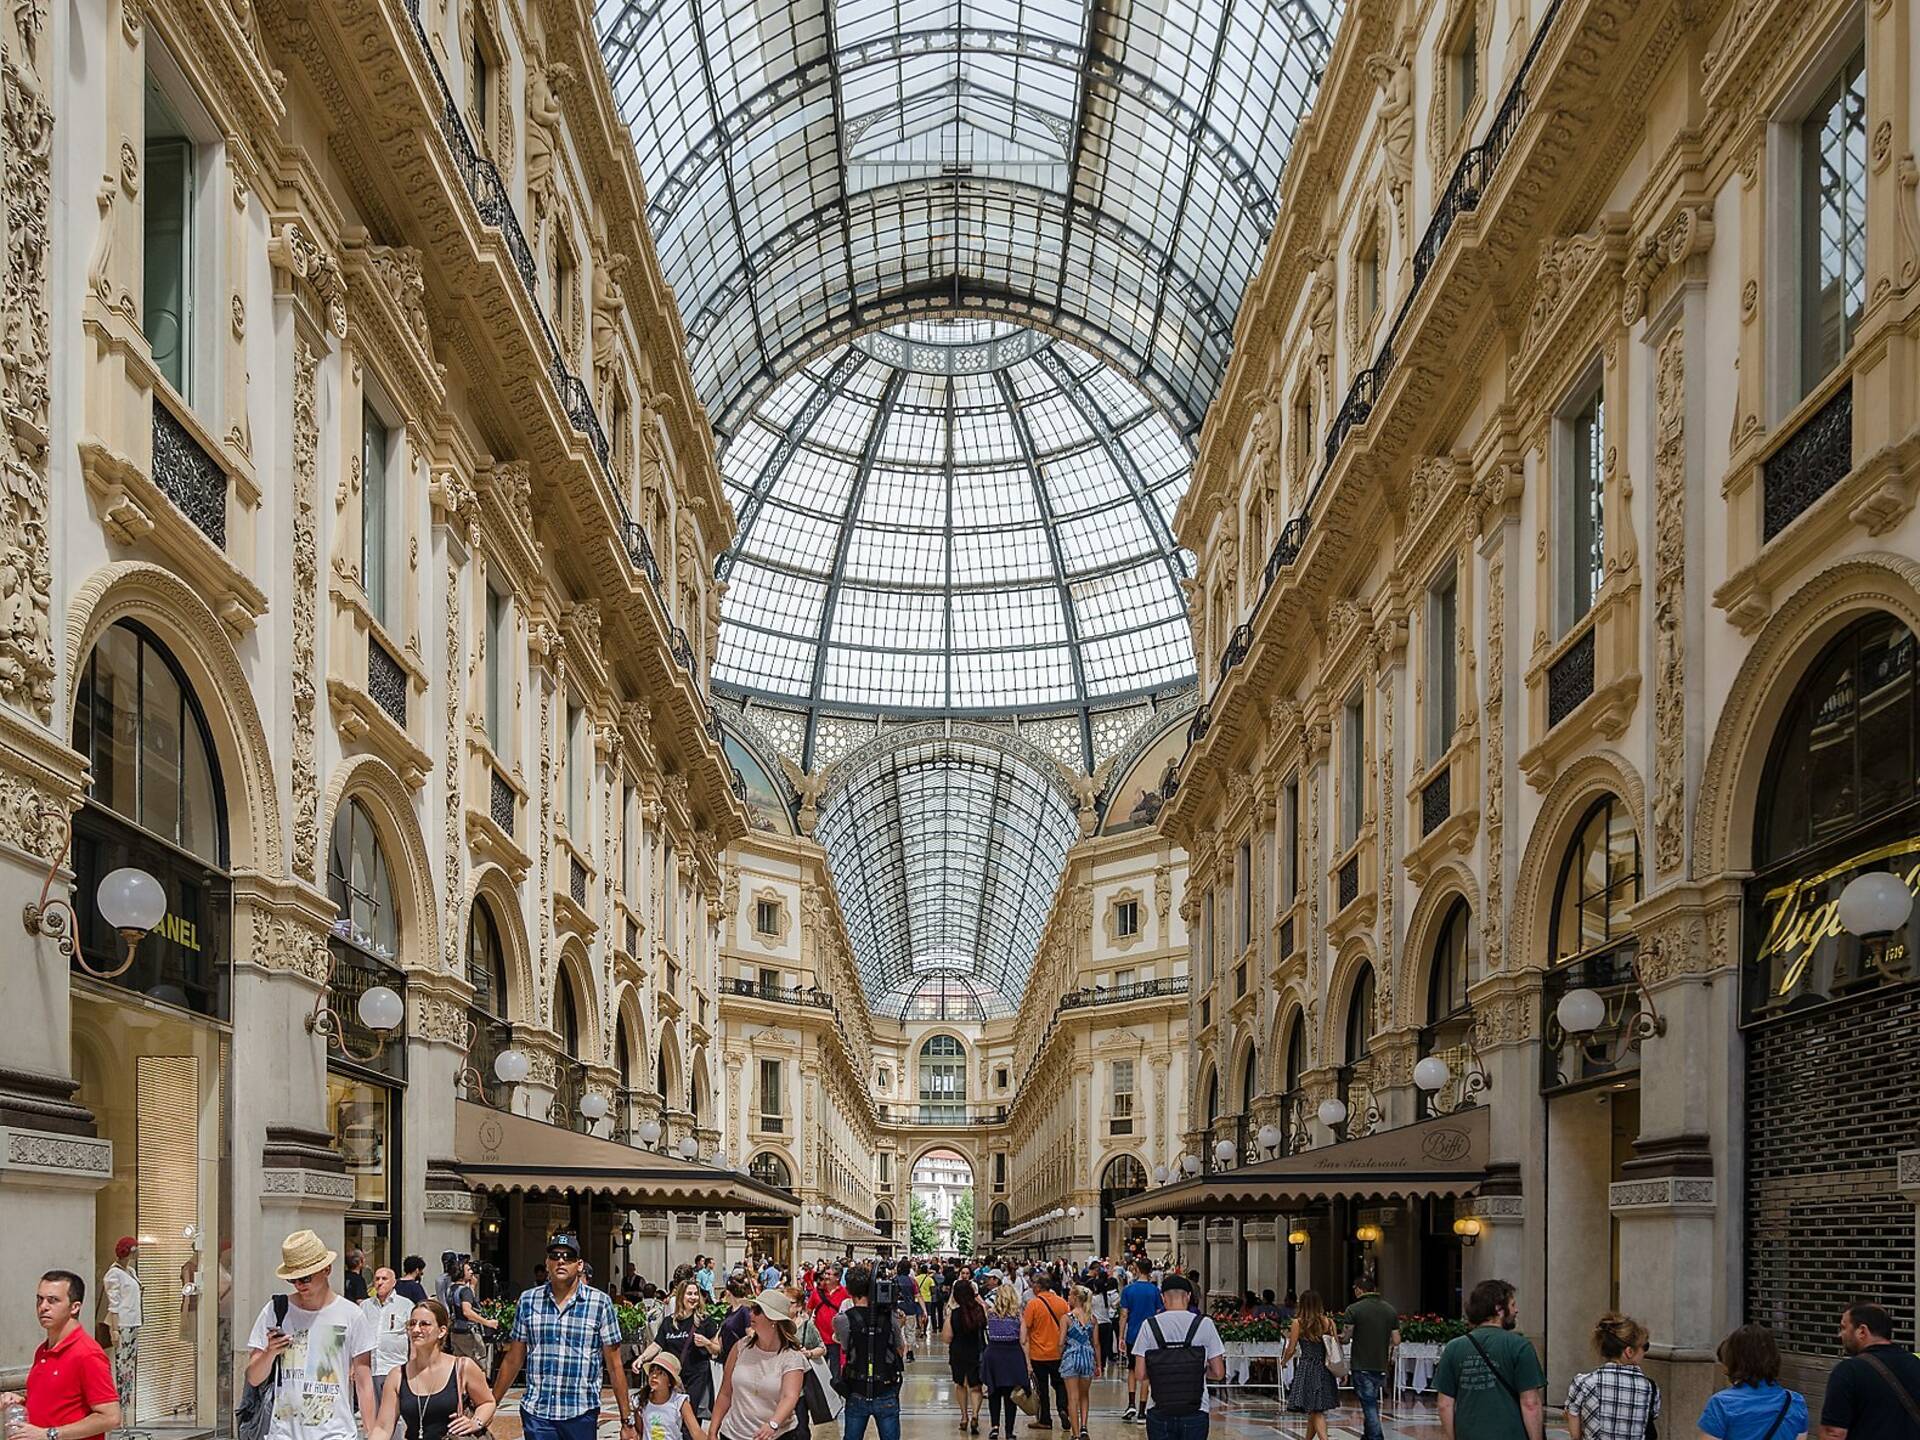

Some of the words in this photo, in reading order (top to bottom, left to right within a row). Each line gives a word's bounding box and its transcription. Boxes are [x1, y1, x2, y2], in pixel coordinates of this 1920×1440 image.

[153, 912, 201, 952] ANEL
[1425, 1132, 1465, 1159] Biffi
[1344, 1157, 1409, 1169] Ristorante
